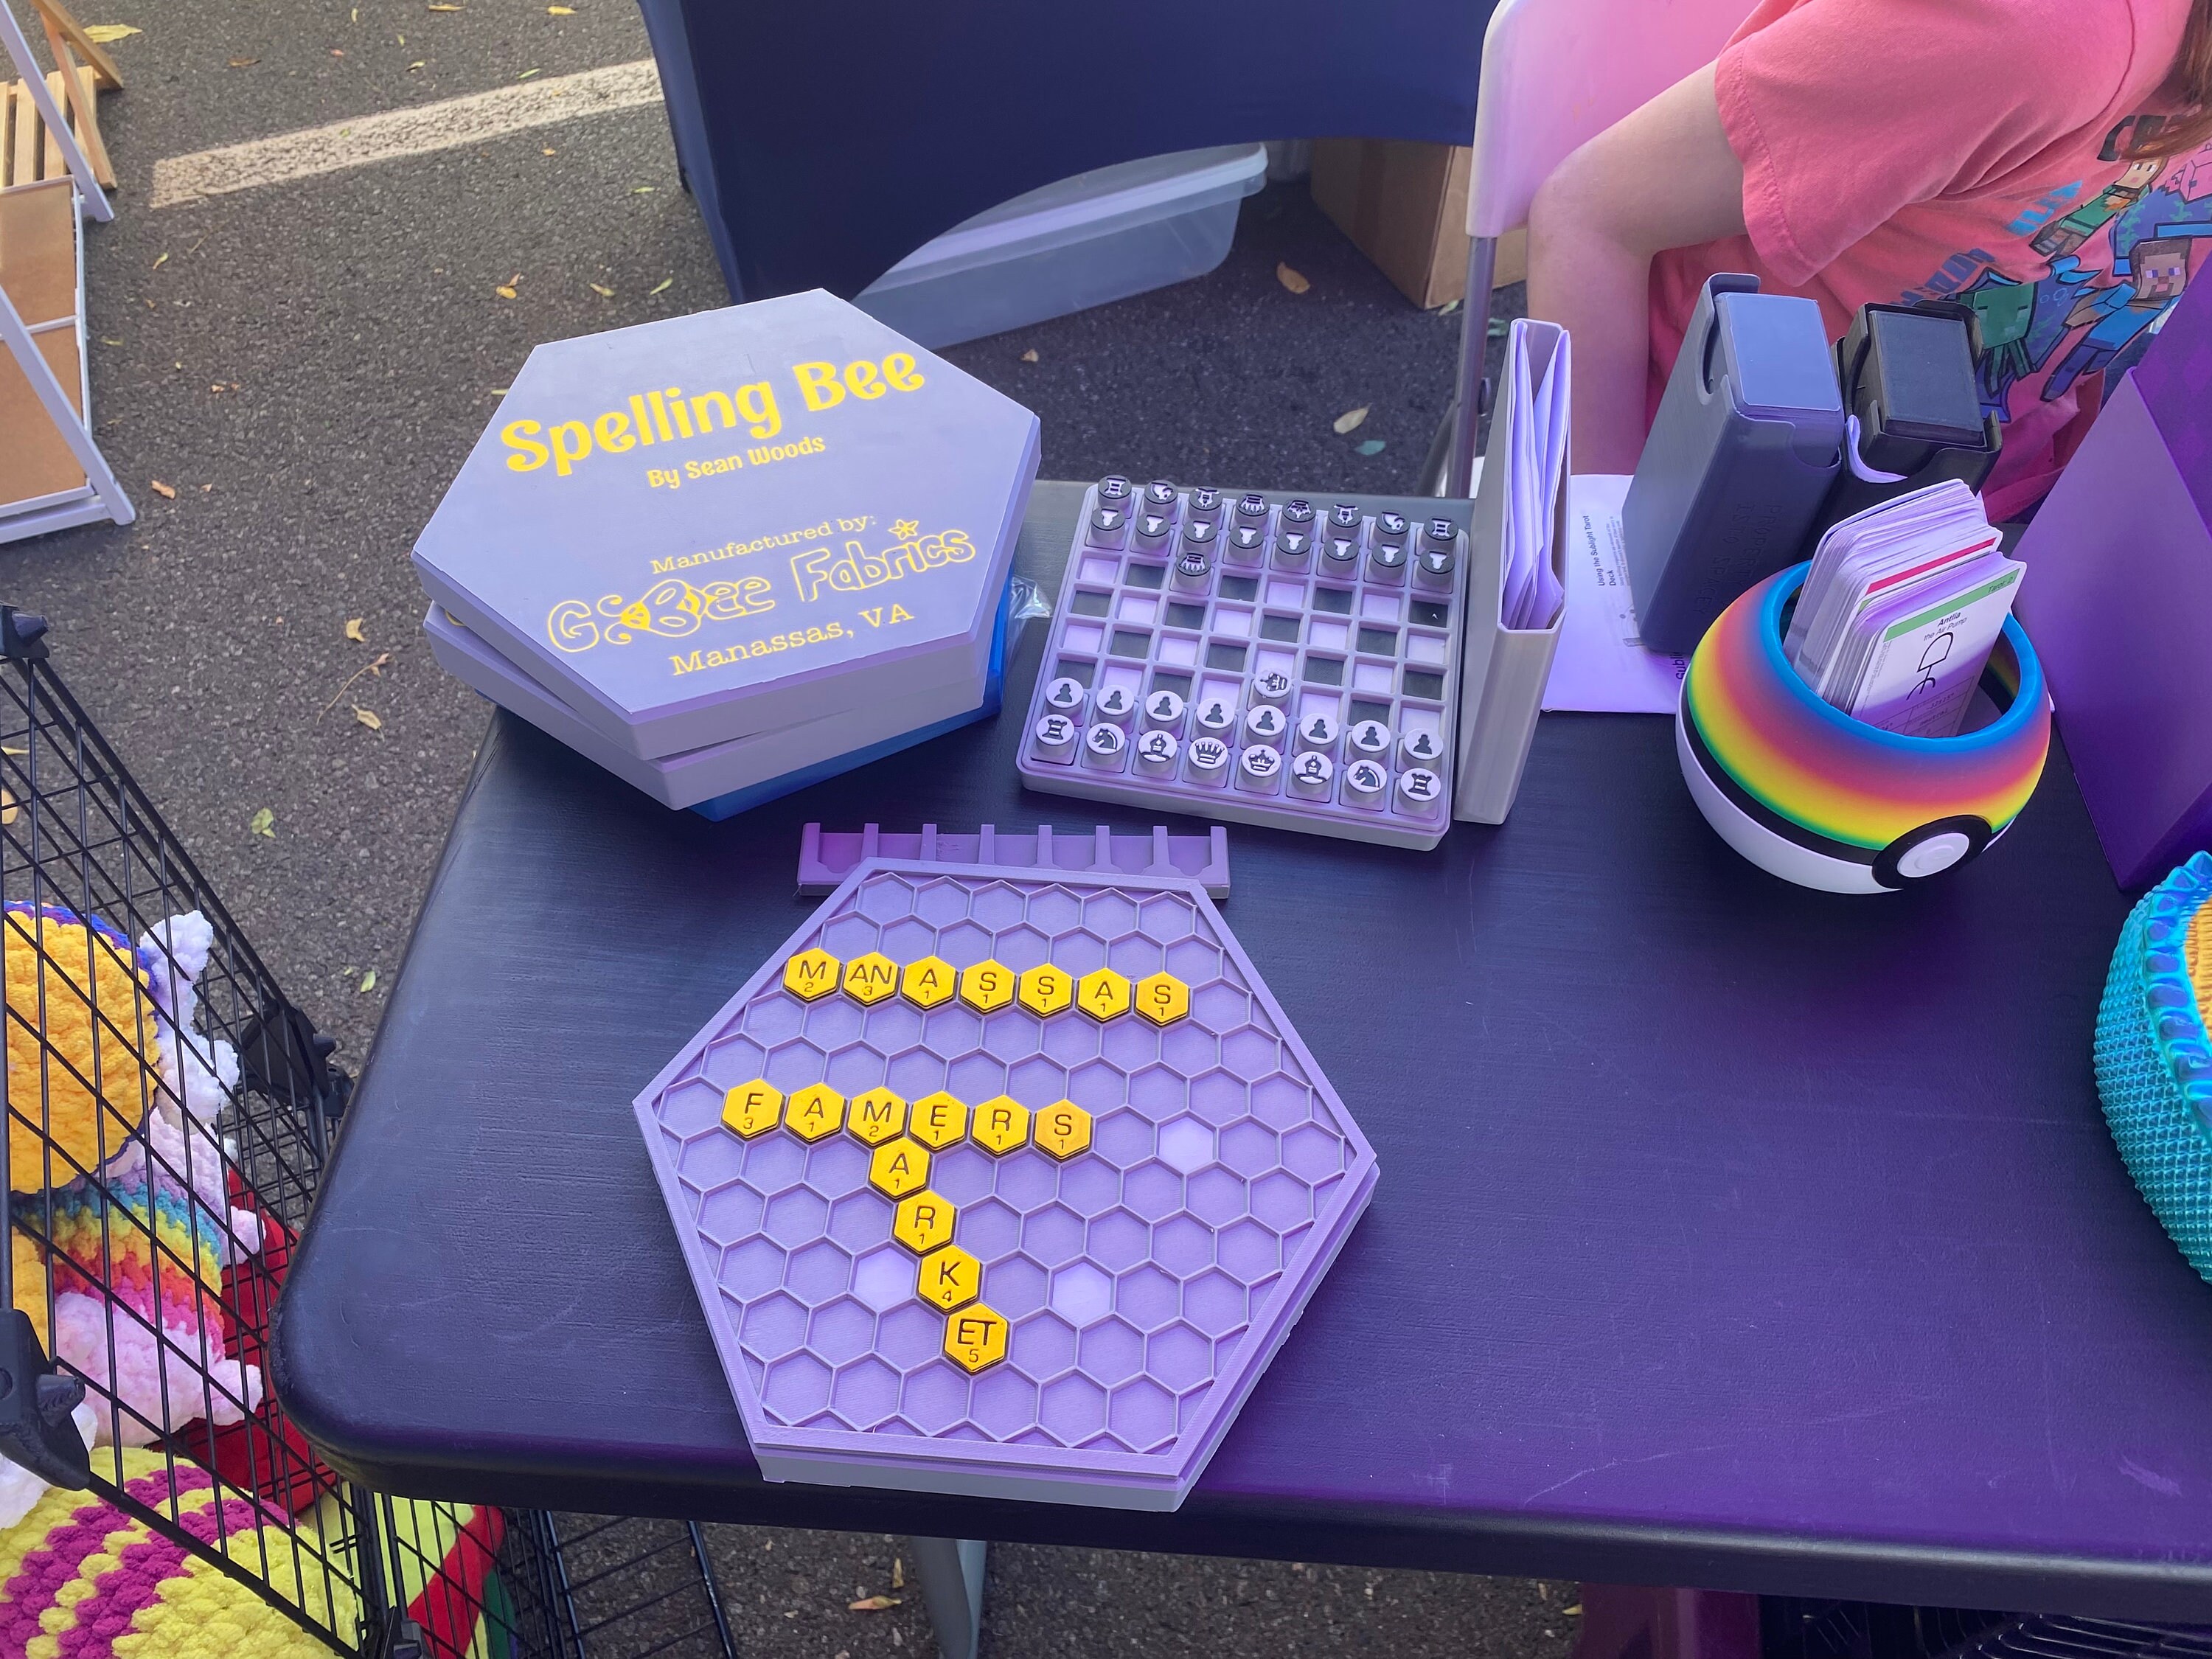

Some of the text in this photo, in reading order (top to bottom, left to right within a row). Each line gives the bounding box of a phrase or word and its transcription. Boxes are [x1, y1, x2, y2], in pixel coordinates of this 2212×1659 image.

[500, 351, 927, 477] Spelling Bee
[646, 435, 827, 490] By Sean Woods
[650, 515, 877, 576] Manufactured by:
[790, 518, 975, 602] Fabrics
[1582, 515, 1606, 586] Using the Sublight Tarot
[1606, 569, 1617, 586] Deck
[669, 604, 914, 676] Manassas, VA
[1937, 611, 1961, 627] Antlia
[1947, 616, 1967, 630] Pump
[804, 981, 1164, 1017] 2 3 1 1 1 1 1
[742, 1116, 1065, 1150] 3 1 2 1 1 1
[894, 1178, 979, 1363] 1 1 4 5
